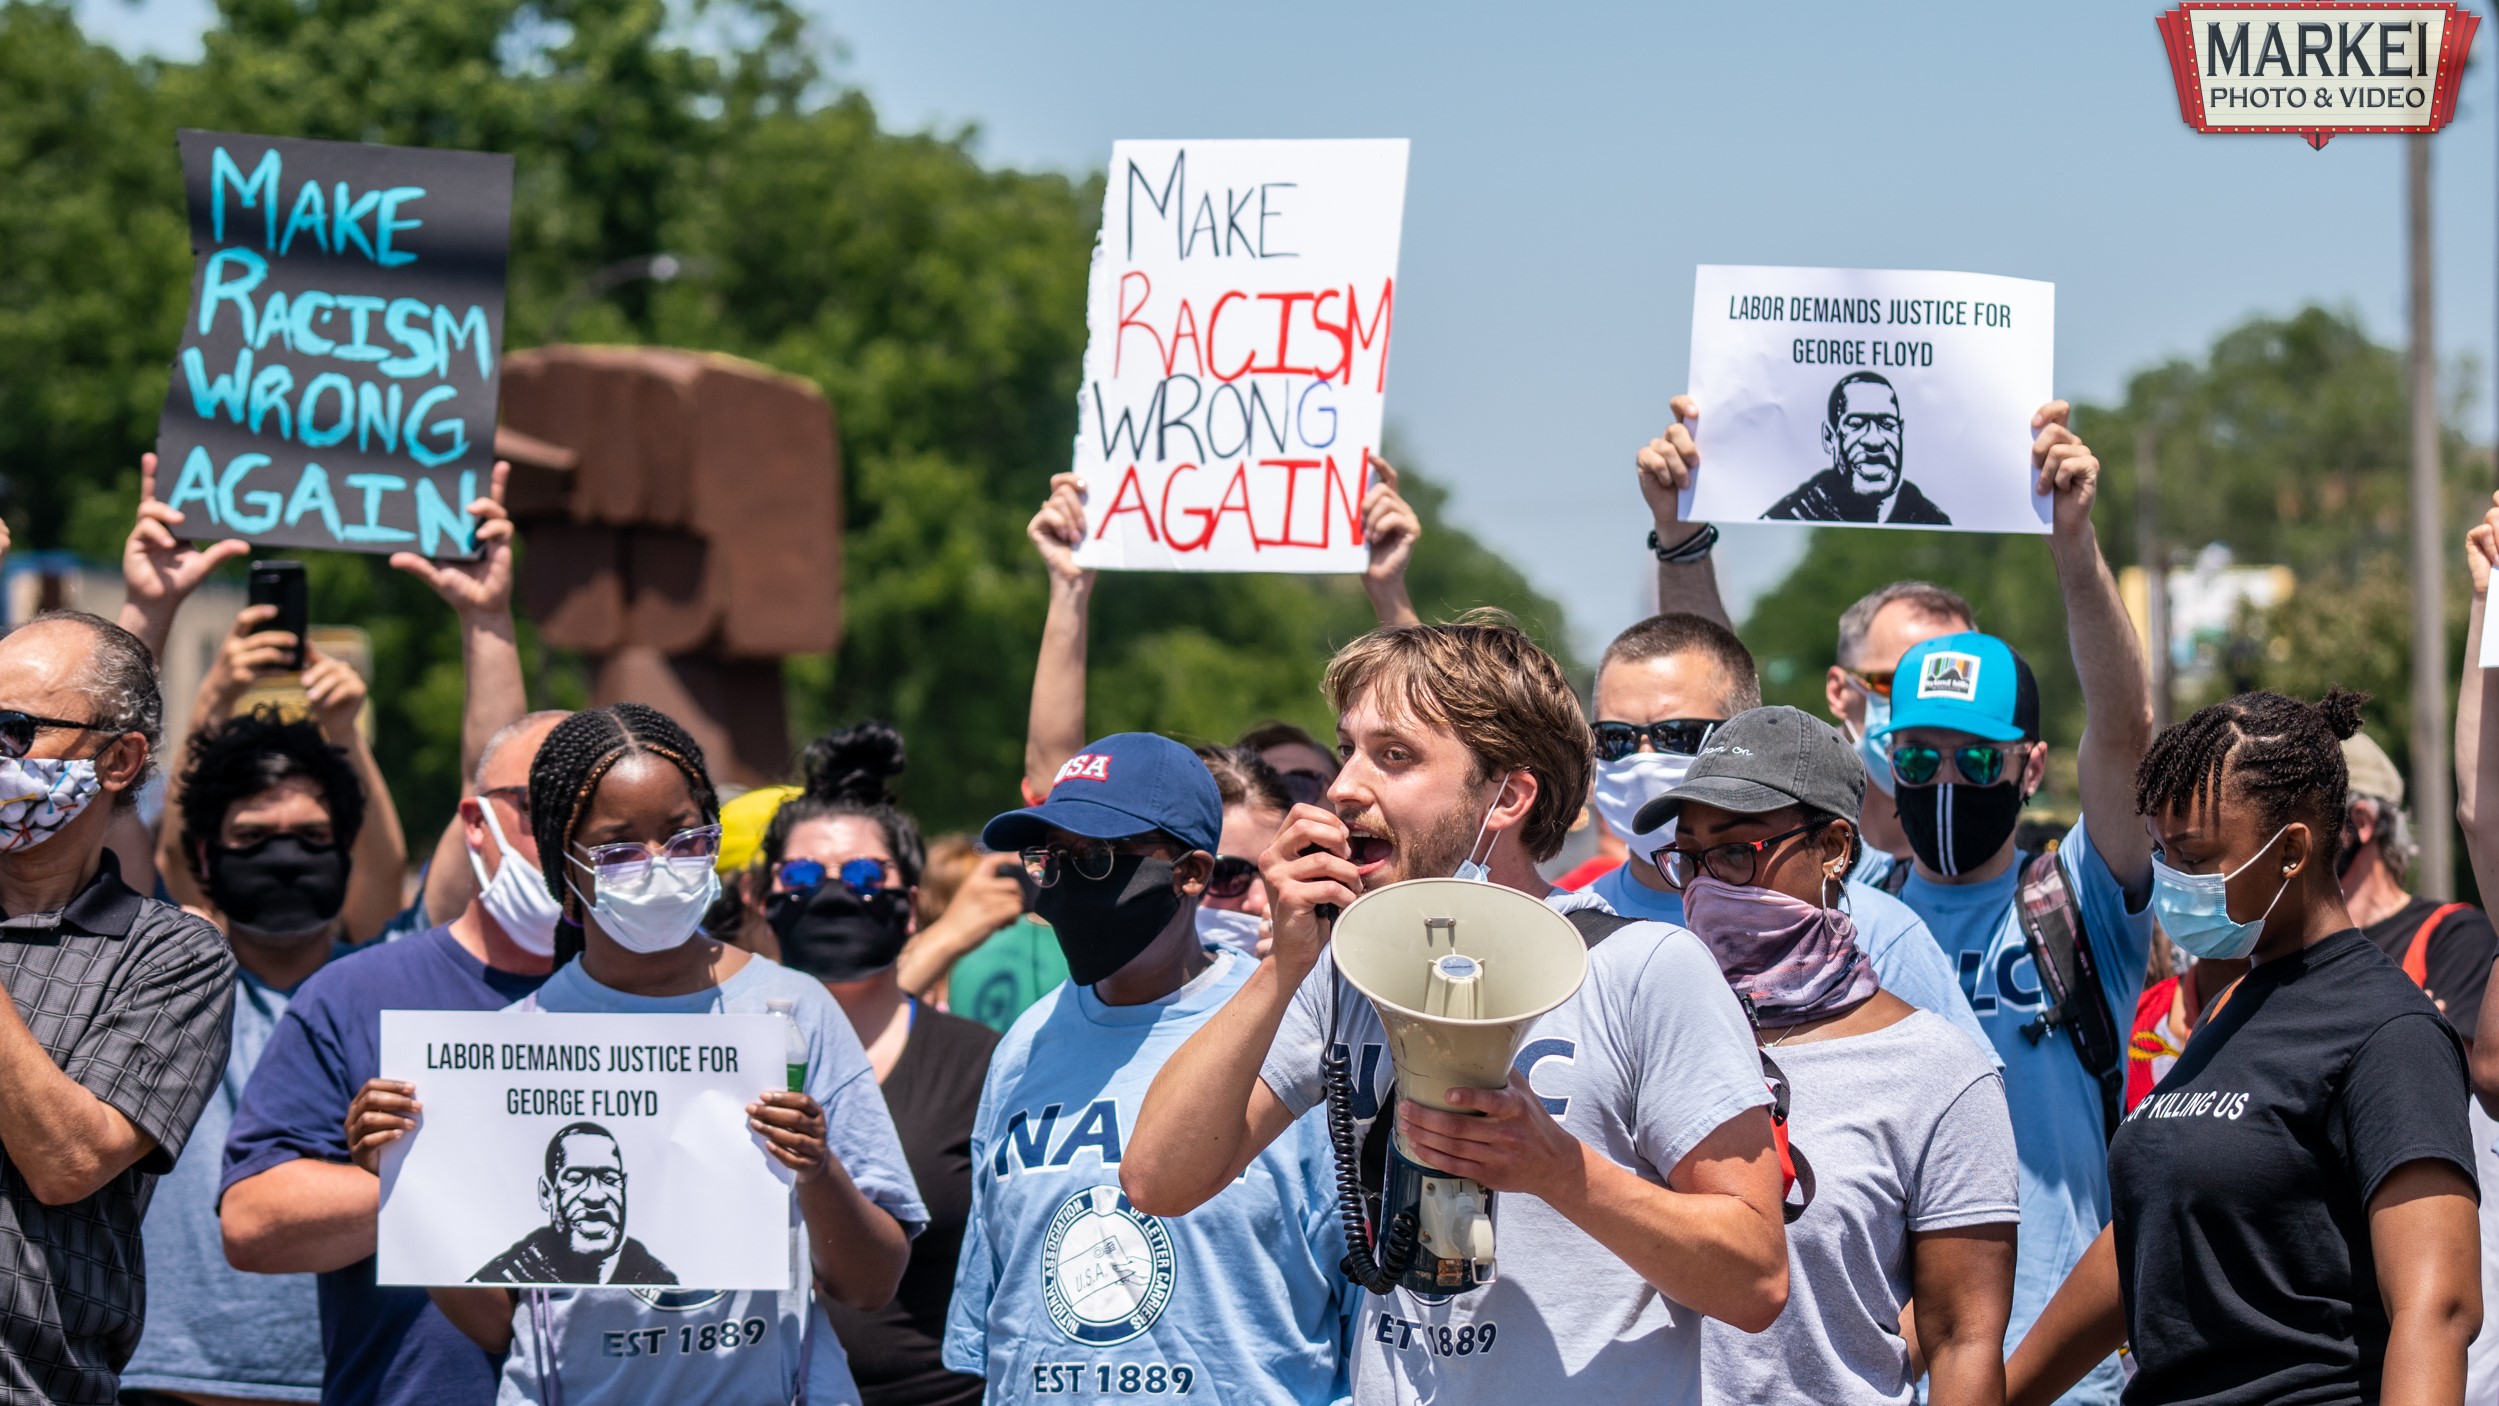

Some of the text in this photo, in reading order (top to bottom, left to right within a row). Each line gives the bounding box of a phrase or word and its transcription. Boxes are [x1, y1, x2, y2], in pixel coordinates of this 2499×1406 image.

[211, 146, 426, 266] MAKE
[1127, 148, 1300, 261] MAKE
[198, 246, 492, 381] RACISM
[1114, 270, 1393, 394] RACISM
[1729, 295, 2011, 328] LABOR DEMANDS JUSTICE FOR
[1792, 339, 1934, 367] GEORGE FLOYD
[182, 346, 469, 467] WRONG
[1094, 373, 1337, 464] WRONG
[167, 445, 477, 557] AGAIN
[1095, 446, 1370, 552] AGAIN
[1732, 746, 1753, 756] On
[427, 1042, 739, 1073] LABOR DEMANDS JUSTICE FOR
[506, 1088, 659, 1117] GEORGE FLOYD
[2148, 1091, 2217, 1119] KILLING
[2213, 1092, 2249, 1120] US
[1045, 1198, 1085, 1276] ASSOCIATION
[1143, 1215, 1170, 1268] LETTER
[1075, 1263, 1108, 1293] U.S.A.
[1130, 1272, 1170, 1331] CARRIERS
[1046, 1280, 1080, 1335] NATIONAL
[602, 1316, 767, 1357] EST 1889
[1427, 1320, 1498, 1358] 1889
[1033, 1362, 1195, 1395] EST 1889
